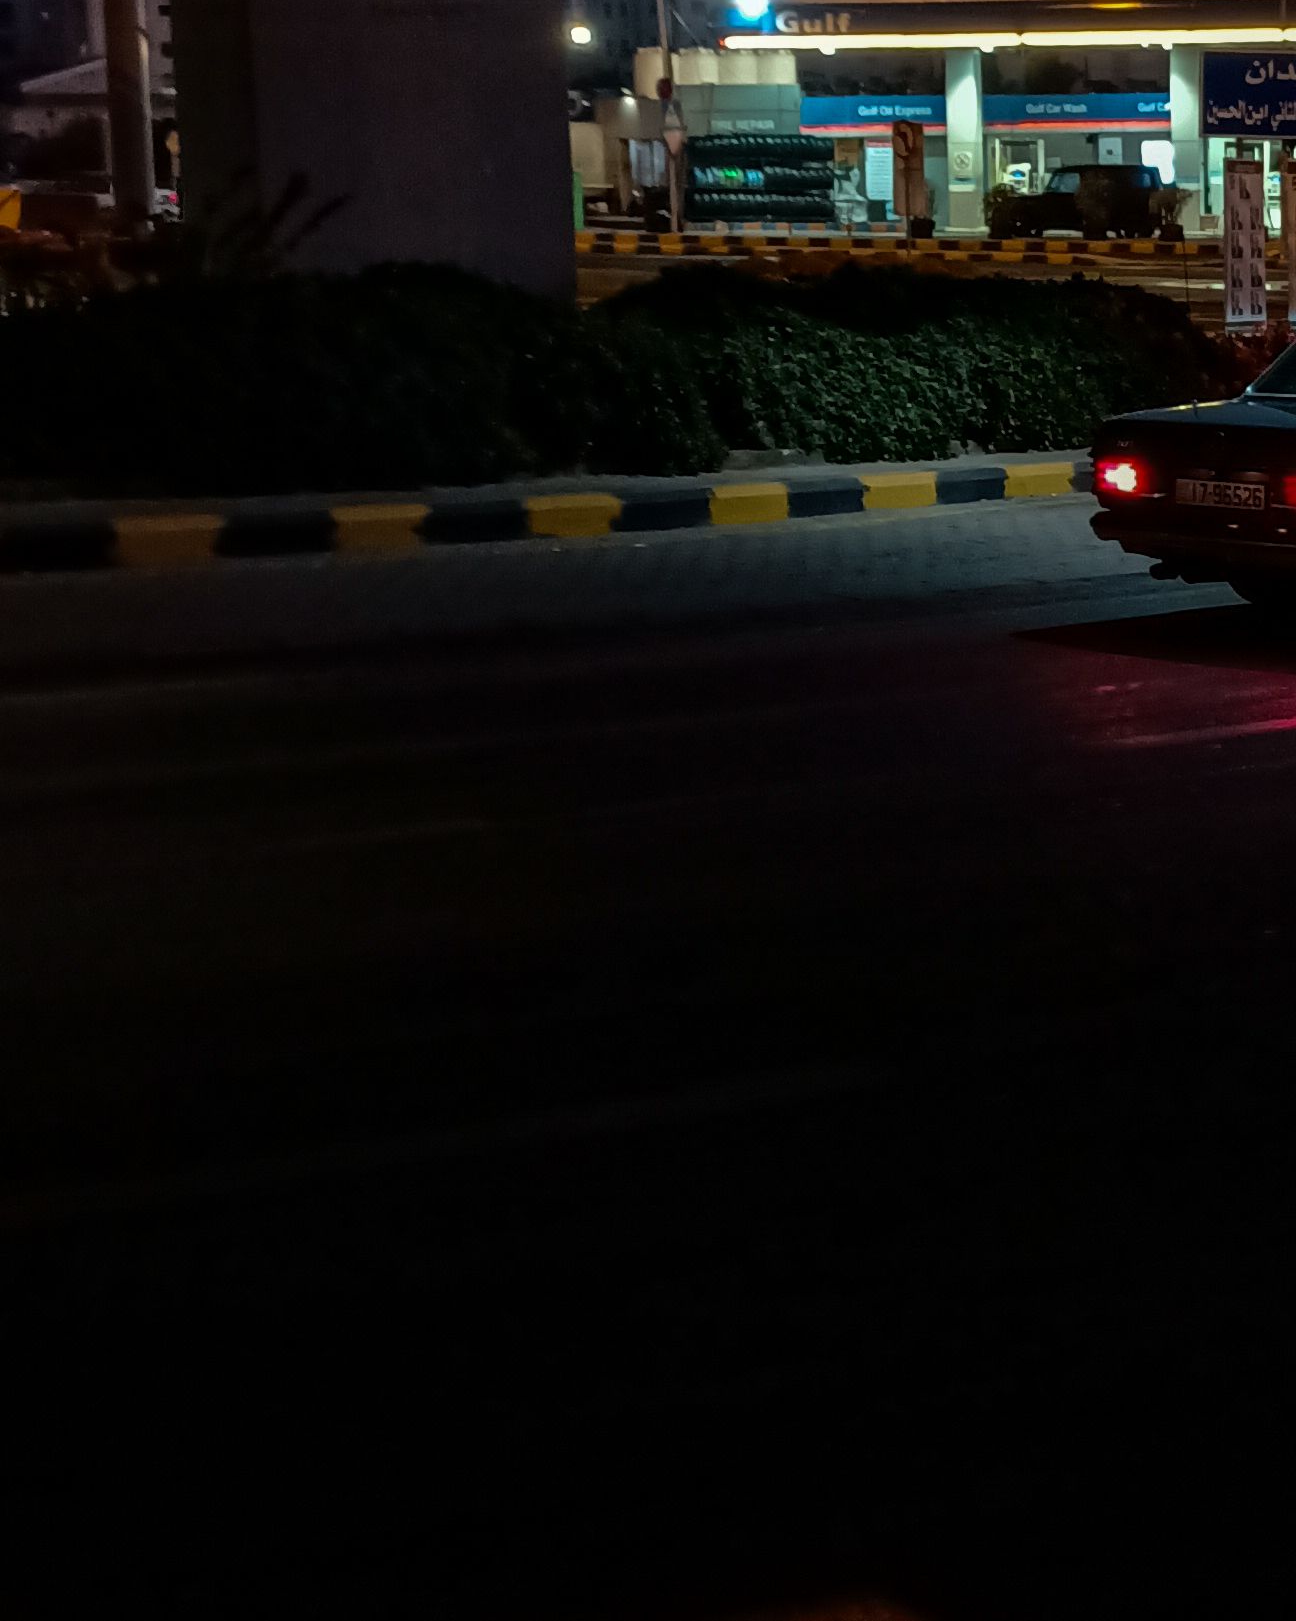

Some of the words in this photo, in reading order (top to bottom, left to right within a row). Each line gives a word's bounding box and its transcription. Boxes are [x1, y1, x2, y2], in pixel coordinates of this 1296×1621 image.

[775, 10, 851, 33] Gulf
[858, 105, 878, 116] Gulf
[895, 105, 932, 117] Express
[1026, 103, 1044, 114] Gulf
[1046, 103, 1061, 114] Car
[1063, 103, 1088, 113] Wash
[1137, 102, 1155, 113] Gulf
[1207, 99, 1245, 125] الحسين
